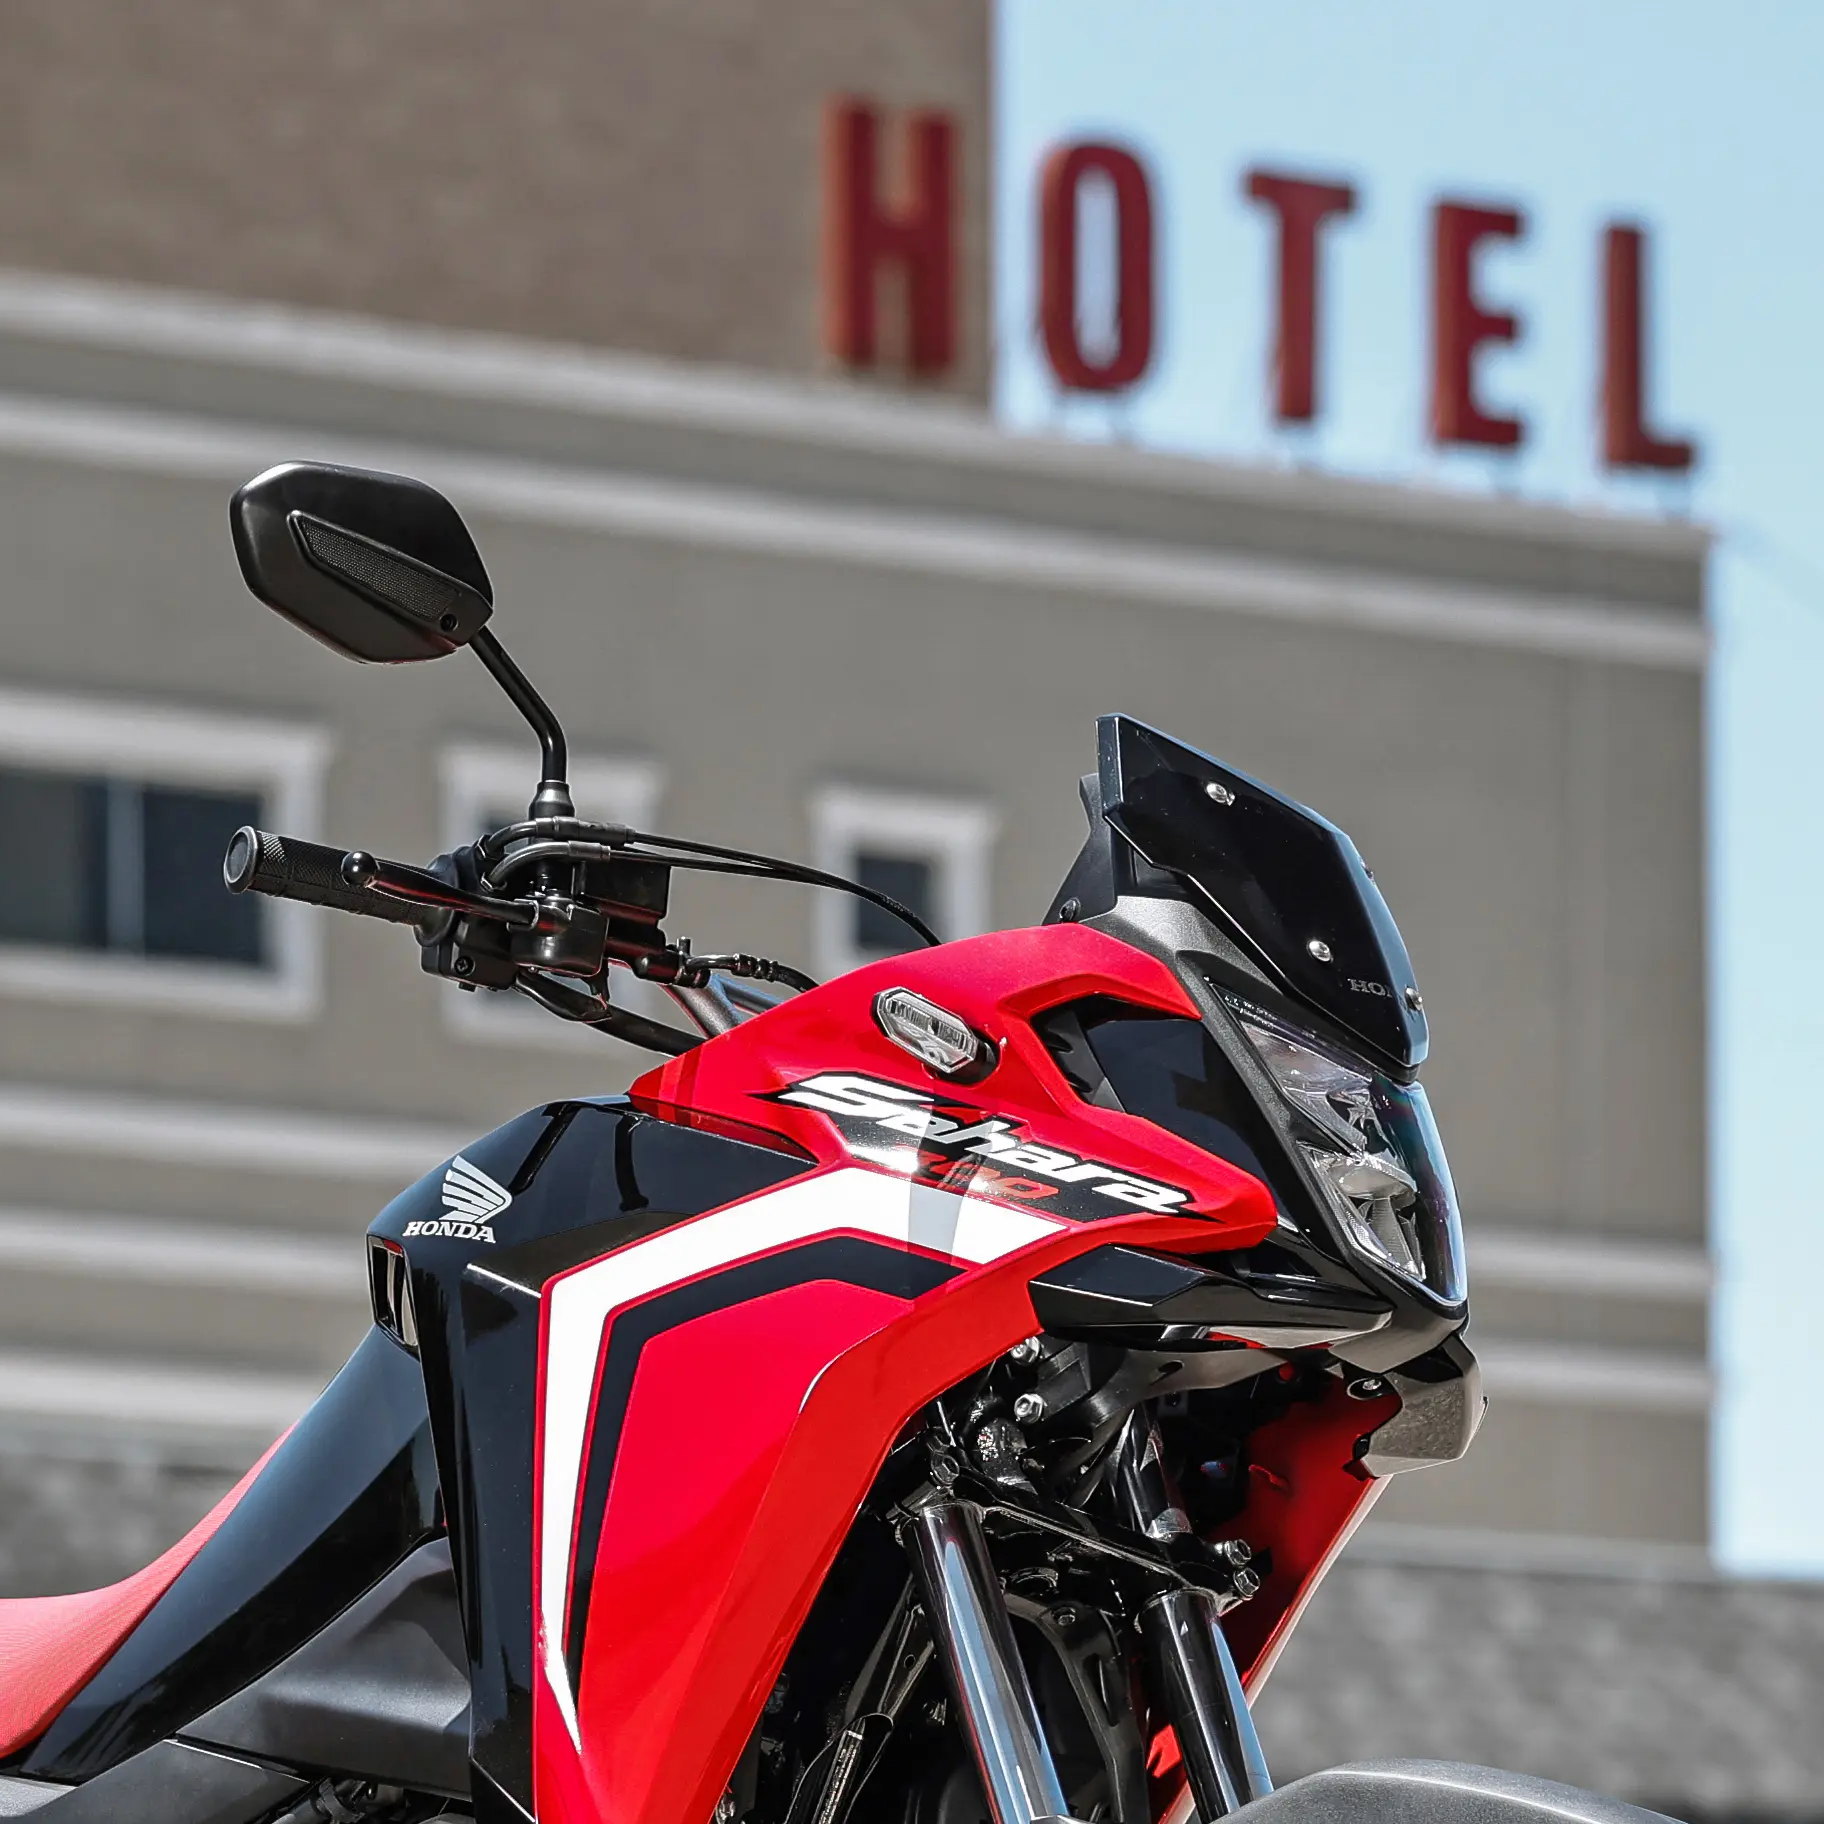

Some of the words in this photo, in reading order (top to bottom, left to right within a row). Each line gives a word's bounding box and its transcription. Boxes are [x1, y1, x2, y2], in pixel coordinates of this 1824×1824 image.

[822, 95, 1694, 470] HOTEL
[777, 1072, 1187, 1212] Sahara
[402, 1220, 496, 1243] HONDA
